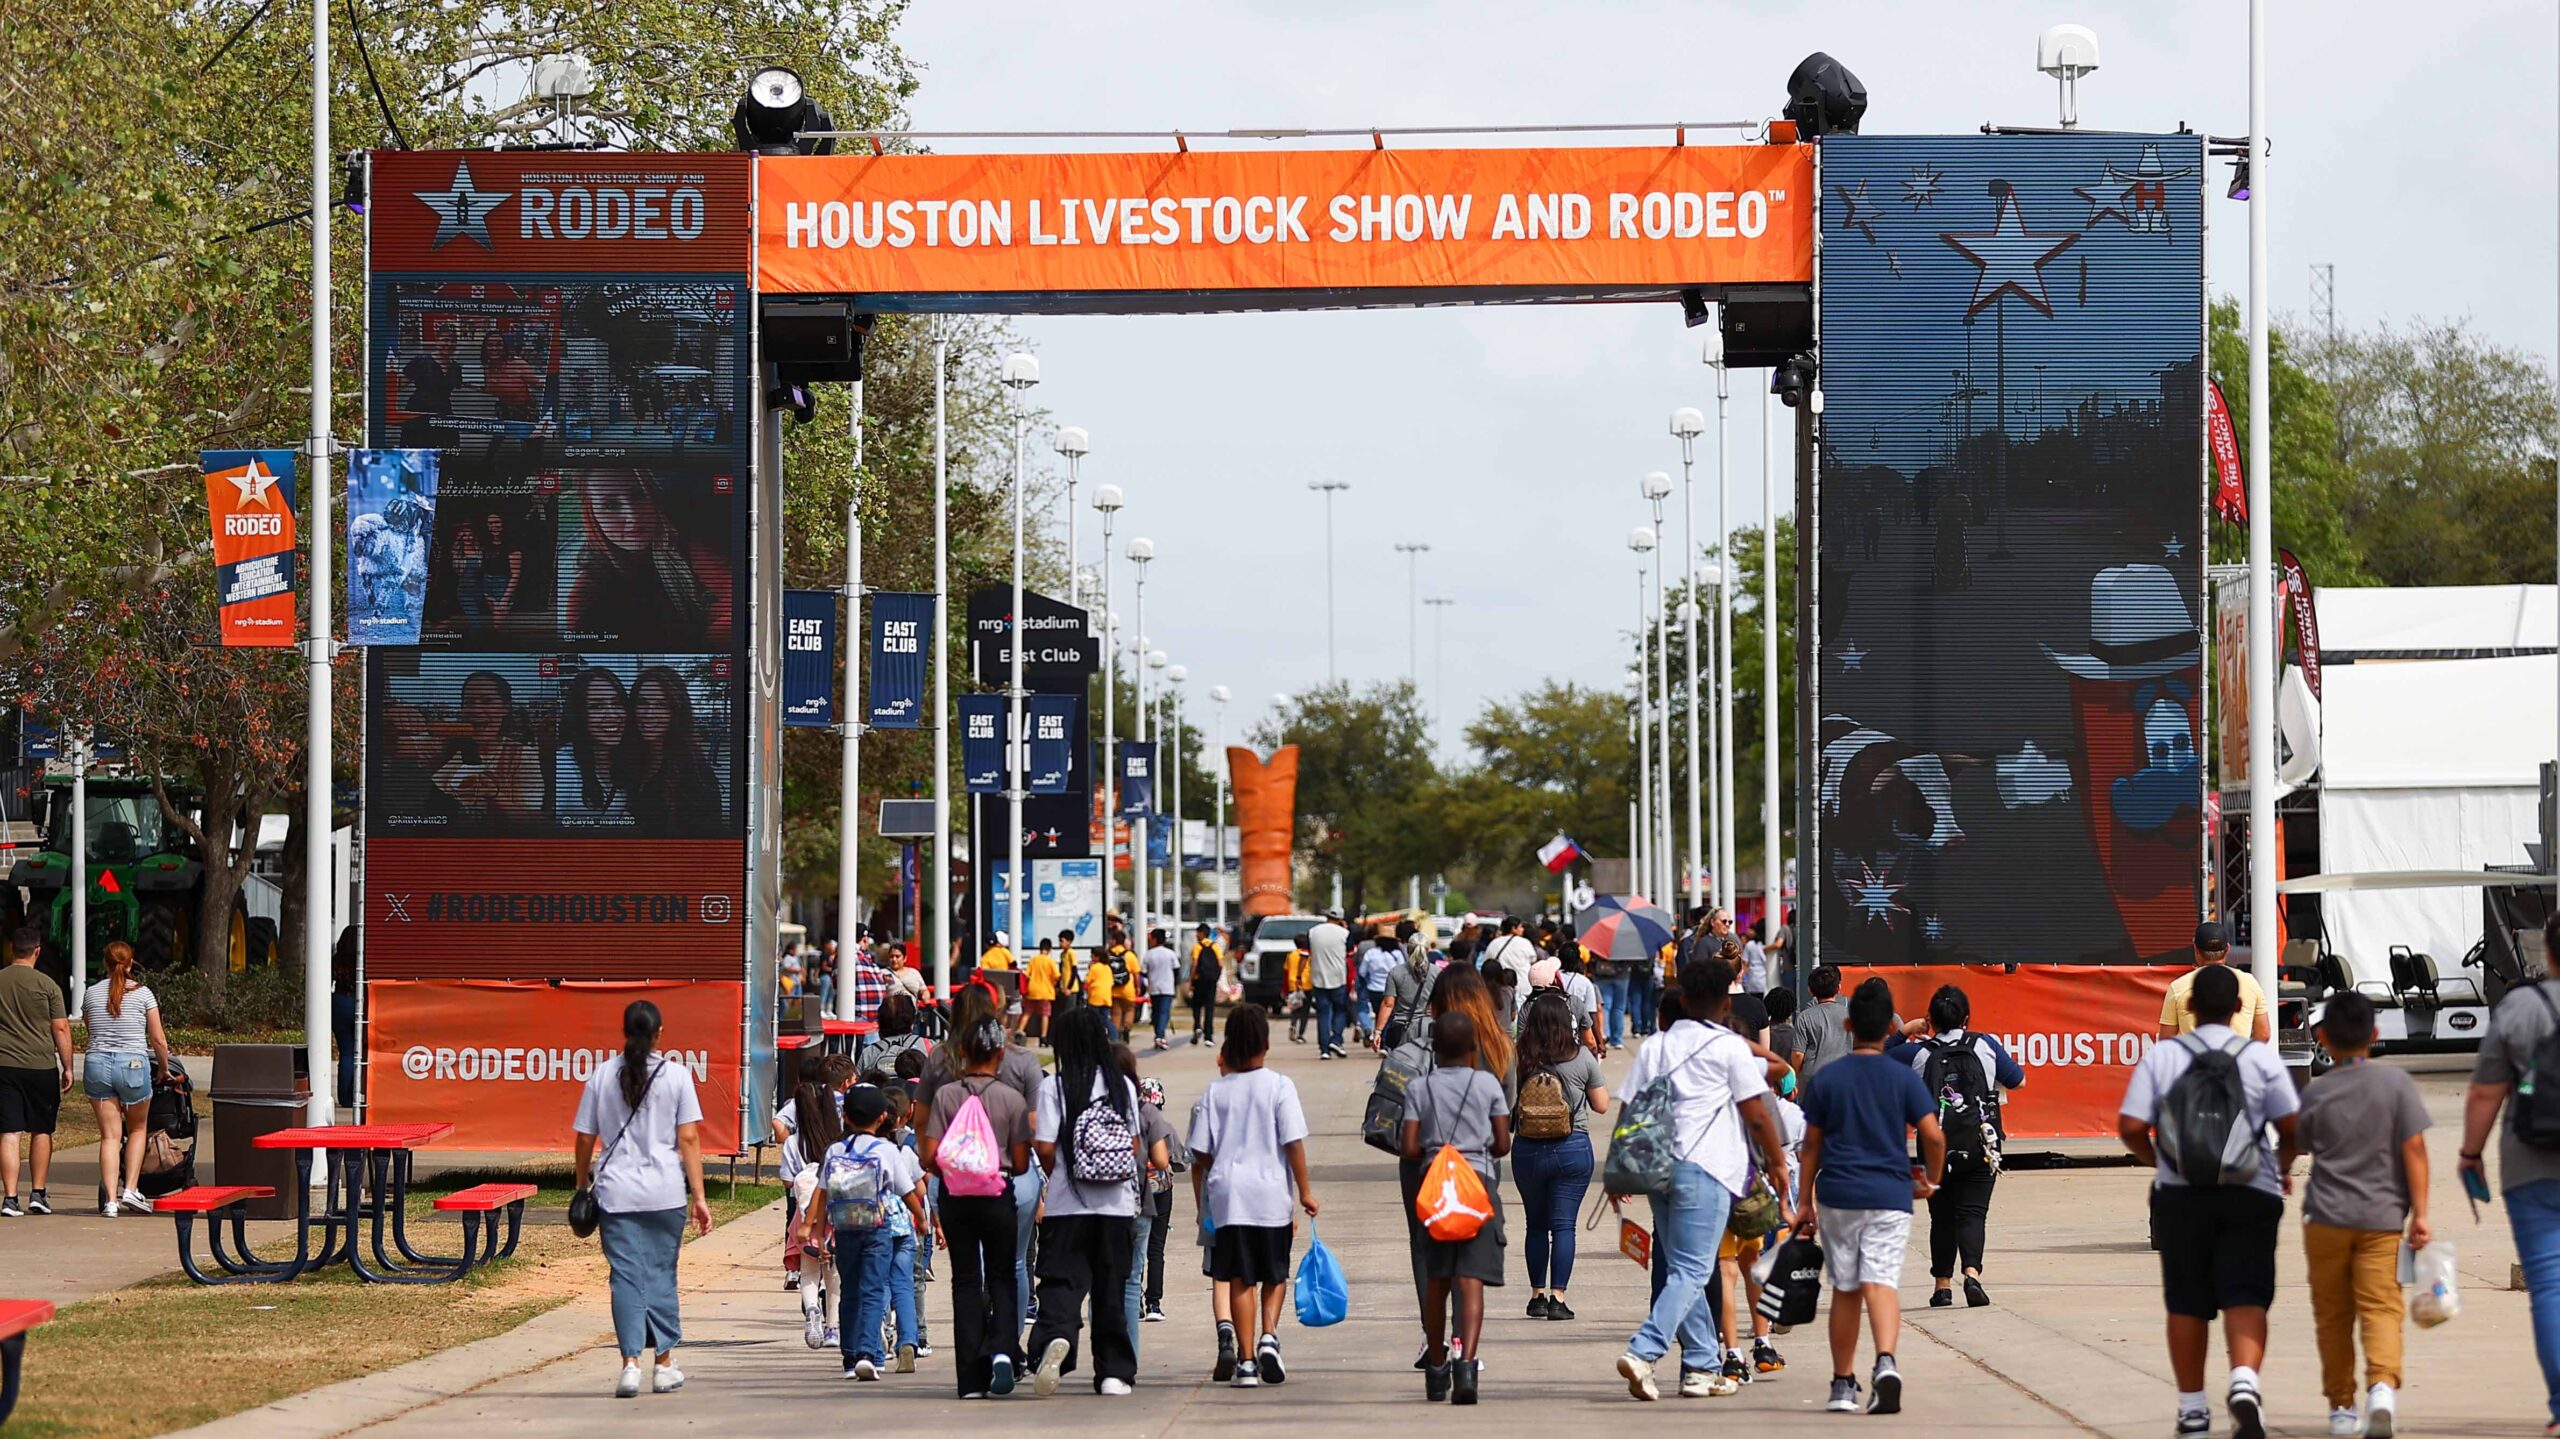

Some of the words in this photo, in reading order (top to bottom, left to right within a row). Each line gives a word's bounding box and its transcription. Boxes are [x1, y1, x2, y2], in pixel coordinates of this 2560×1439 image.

[521, 172, 573, 183] HOUSTON
[576, 173, 640, 184] LIVESTOCK
[644, 173, 677, 184] SHOW
[682, 174, 705, 184] AND
[520, 186, 705, 241] RODEO
[786, 200, 1010, 248] HOUSTON
[1030, 197, 1310, 246] LIVESTOCK
[1329, 193, 1472, 243] SHOW
[1491, 192, 1592, 240] AND
[225, 518, 281, 536] RODEO
[235, 556, 279, 574] AGRICULTURE
[239, 566, 275, 582] EDUCATION
[231, 573, 283, 593] ENTERTAINMENT
[226, 588, 257, 603] WESTERN
[257, 581, 289, 596] HERITAGE
[235, 619, 248, 627] nrg
[255, 618, 283, 626] stadium
[360, 618, 372, 626] nrg
[380, 617, 408, 625] stadium
[789, 619, 822, 635] EAST
[884, 621, 917, 637] EAST
[979, 619, 1004, 634] nrg
[1021, 616, 1080, 629] stadium
[2302, 597, 2315, 646] RANCH
[788, 635, 822, 651] CLUB
[883, 637, 917, 653] CLUB
[1000, 648, 1036, 662] Est
[1041, 648, 1081, 662] Club
[788, 706, 819, 714] stadium
[805, 698, 819, 708] nrg
[891, 700, 905, 709] nrg
[874, 707, 905, 716] stadium
[969, 715, 994, 726] EAST
[1038, 716, 1064, 727] EAST
[968, 727, 994, 738] CLUB
[1038, 727, 1064, 739] CLUB
[1127, 757, 1147, 767] EAST
[426, 893, 689, 923] #RODEOHOUSTON
[402, 1046, 707, 1083] @RODEOHON
